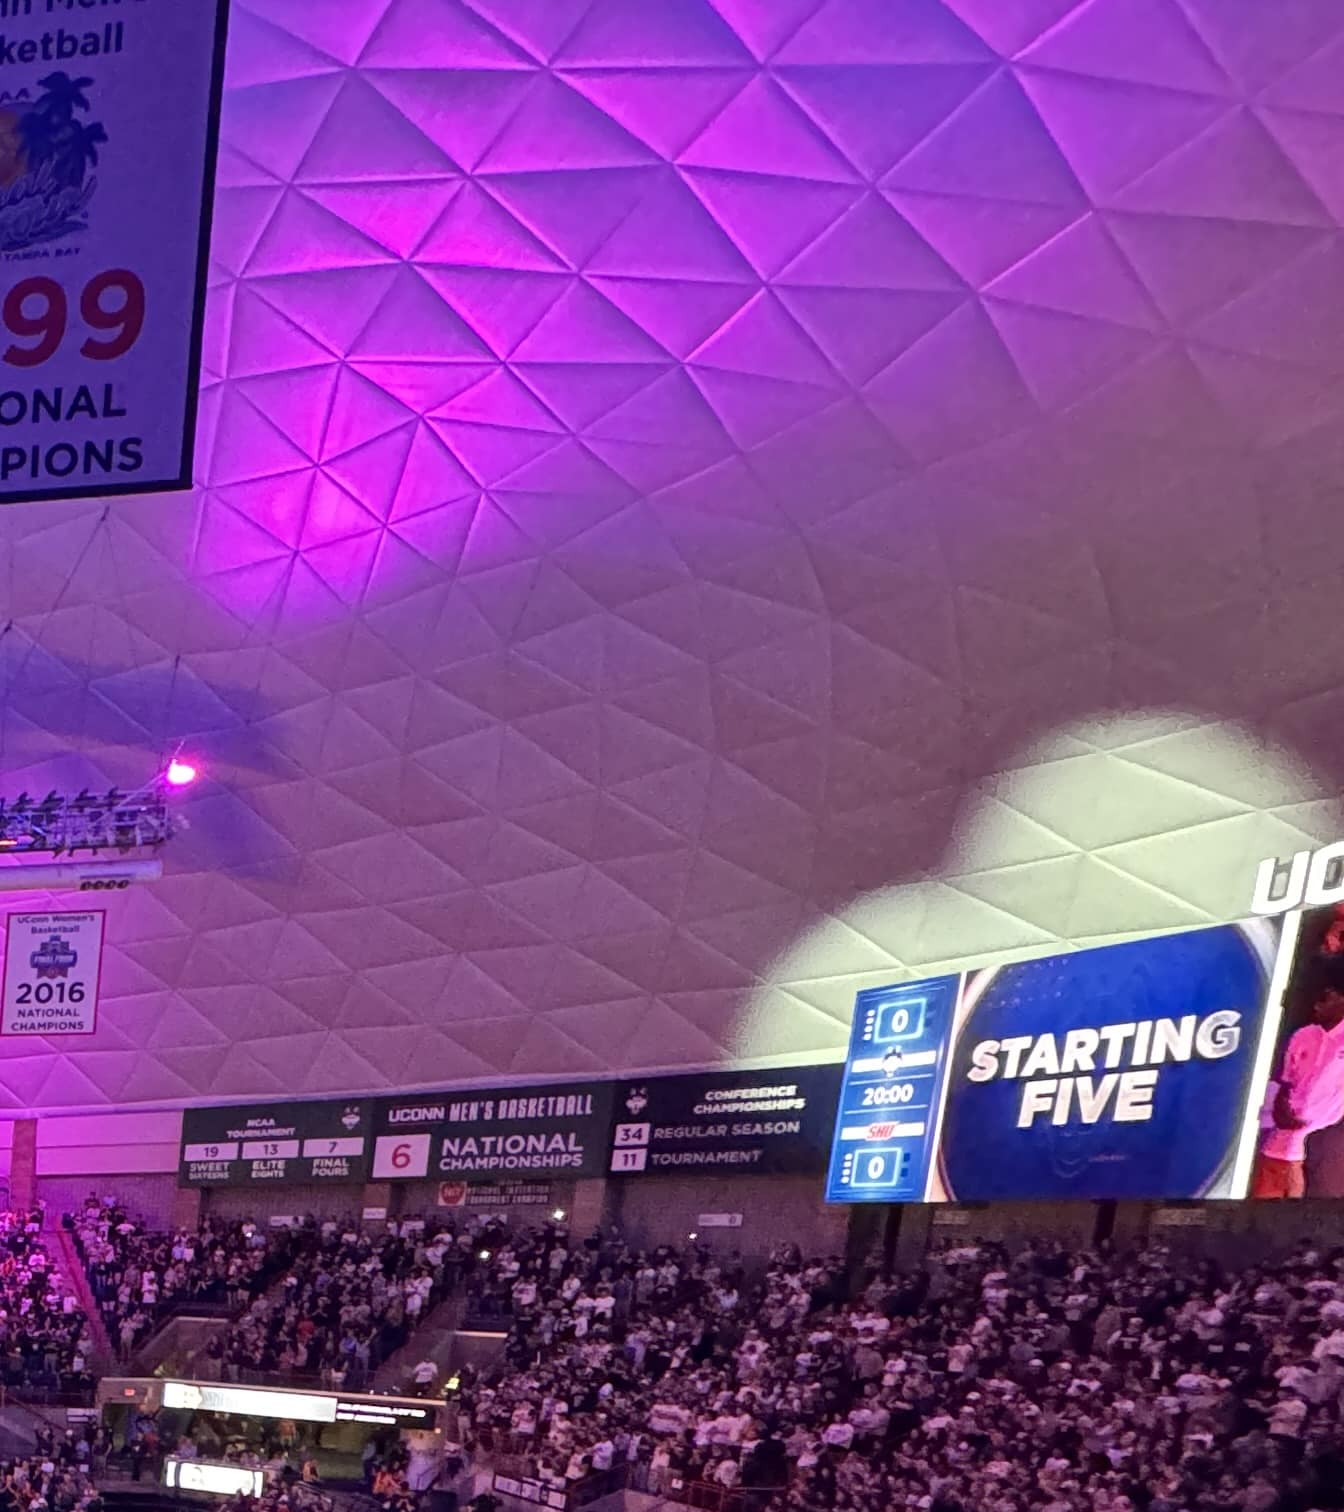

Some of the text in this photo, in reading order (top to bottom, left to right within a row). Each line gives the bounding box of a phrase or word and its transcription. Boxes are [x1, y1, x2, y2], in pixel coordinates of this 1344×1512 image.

[16, 982, 85, 1004] 2016
[17, 1008, 80, 1018] NATIONAL
[892, 1009, 909, 1032] 0
[11, 1021, 84, 1031] CHAMPIONS
[968, 1010, 1242, 1082] STARTING
[705, 1085, 797, 1100] CONFERENCE
[862, 1084, 913, 1106] 20:00
[1018, 1070, 1157, 1128] FIVE
[389, 1094, 592, 1122] UCONN MEN'S BASKETBALL
[694, 1099, 806, 1114] CHAMPIONSHIPS
[247, 1119, 275, 1127] NCAA
[654, 1121, 800, 1139] REGULAR SEASON
[866, 1123, 895, 1138] SHU
[227, 1128, 295, 1138] TOURNAMENT
[620, 1128, 642, 1141] 34
[204, 1146, 219, 1157] 19
[263, 1144, 278, 1155] 13
[329, 1142, 337, 1153] 7
[442, 1132, 583, 1156] NATIONAL
[313, 1158, 349, 1167] FINAL
[391, 1144, 411, 1168] 6
[439, 1153, 583, 1171] CHAMPIONSHIPS
[622, 1153, 637, 1165] 11
[651, 1150, 763, 1165] TOURNAMENT
[190, 1162, 229, 1172] SWEET
[252, 1160, 285, 1169] ELITE
[868, 1156, 884, 1179] 0
[251, 1170, 284, 1178] EIGHTS
